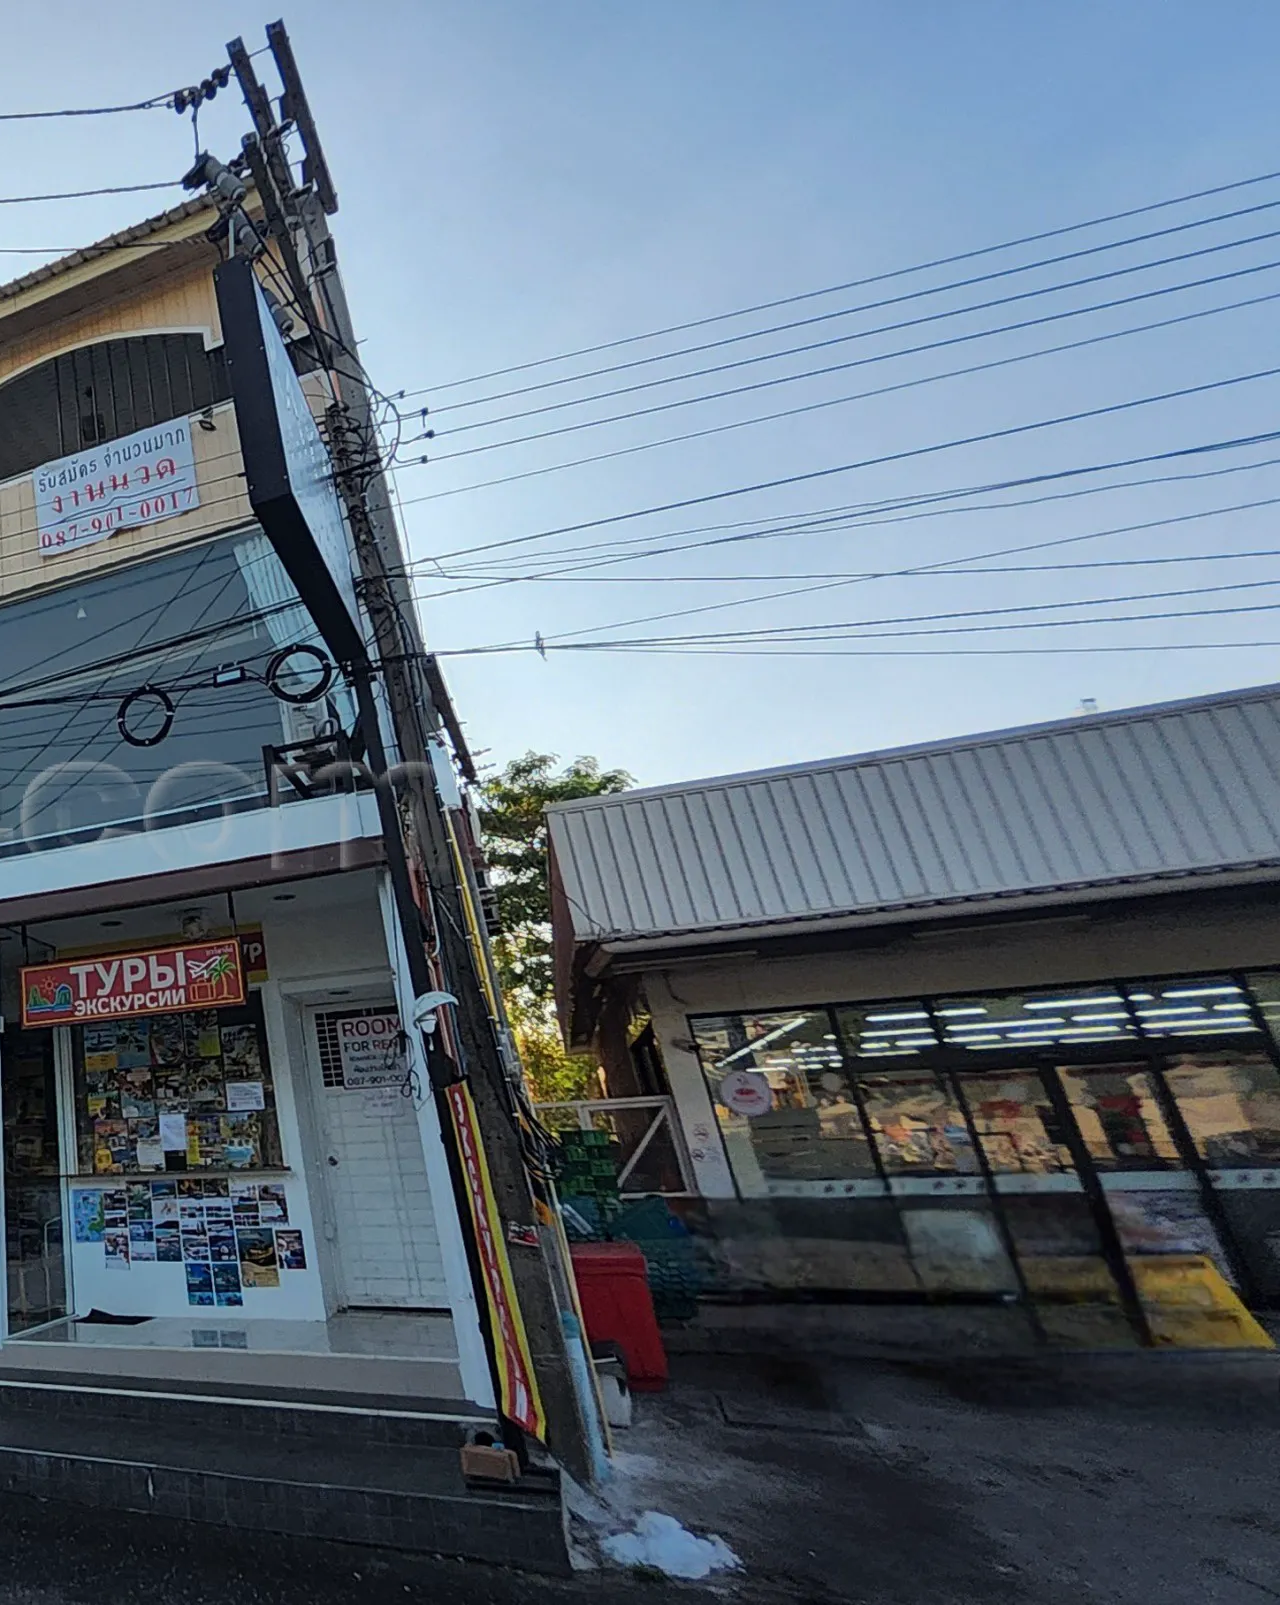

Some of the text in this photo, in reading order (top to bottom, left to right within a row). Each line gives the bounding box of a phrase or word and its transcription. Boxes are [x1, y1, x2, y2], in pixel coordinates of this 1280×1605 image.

[39, 428, 185, 493] รับสมัคร จำนวนมาก
[52, 458, 176, 513] งานนวด
[70, 951, 186, 998] ТУРЫ
[73, 988, 186, 1017] ЭКСКУРСИИ
[341, 1018, 401, 1038] ROOM
[343, 1041, 370, 1053] FOR
